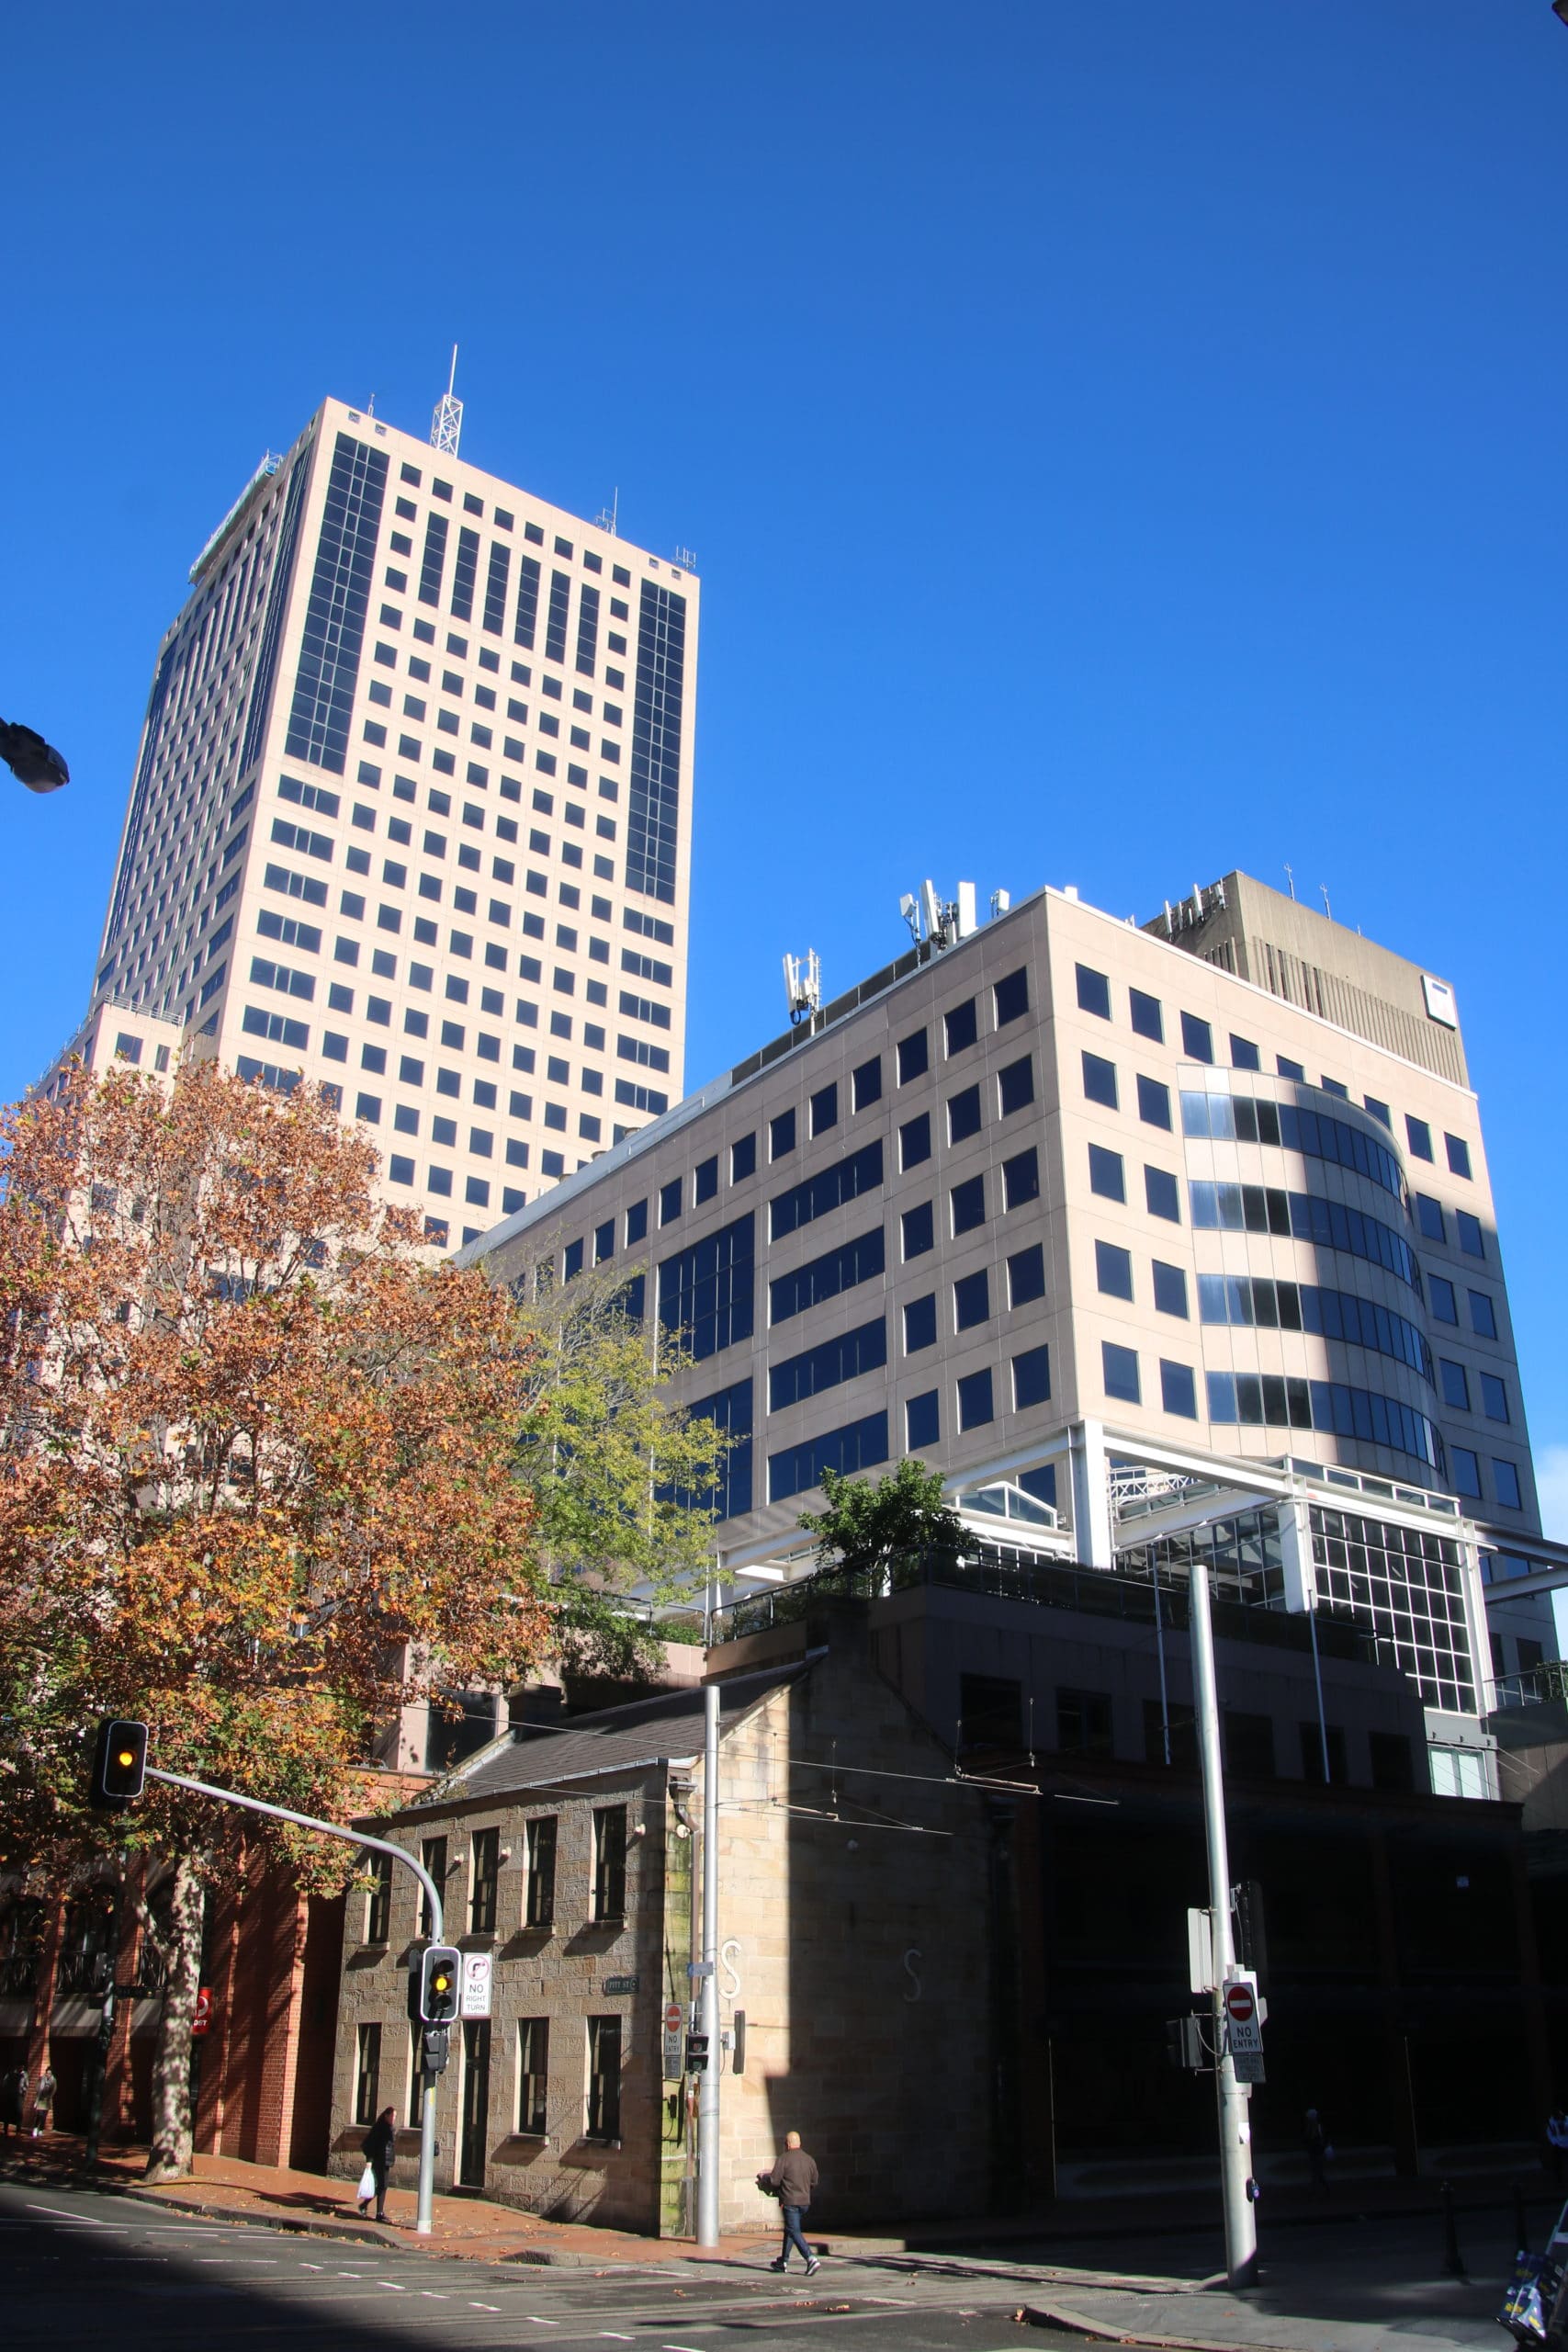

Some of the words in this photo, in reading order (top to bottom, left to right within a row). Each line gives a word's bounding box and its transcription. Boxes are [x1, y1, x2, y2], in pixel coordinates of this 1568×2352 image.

[469, 1984, 484, 1993] NO
[1236, 2027, 1252, 2038] NO
[668, 2035, 678, 2043] NO
[1233, 2039, 1258, 2049] ENTRY
